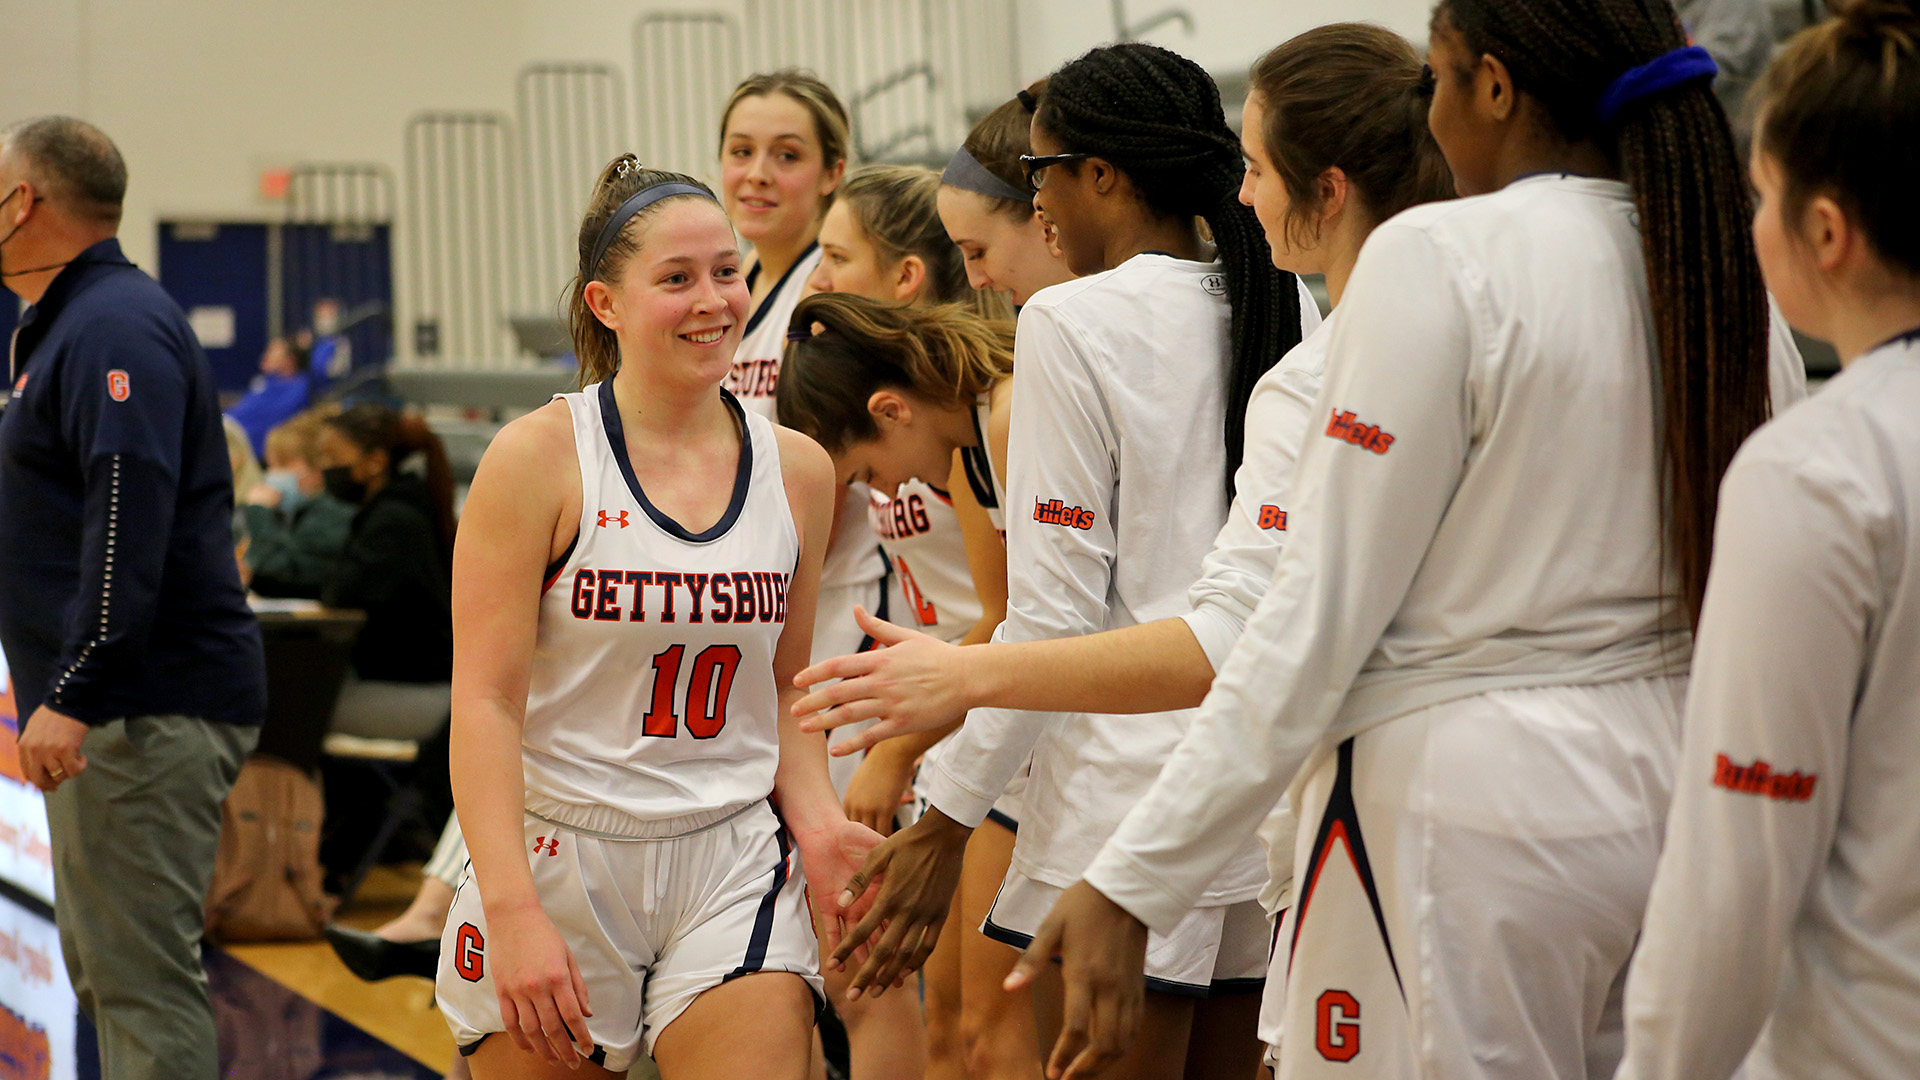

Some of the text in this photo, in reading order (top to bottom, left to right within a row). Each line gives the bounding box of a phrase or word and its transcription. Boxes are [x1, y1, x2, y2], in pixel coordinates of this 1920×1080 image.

[107, 369, 131, 402] G
[571, 568, 789, 623] GETTYSBUR
[642, 644, 742, 739] 10
[455, 921, 485, 983] G
[1315, 989, 1361, 1063] G
